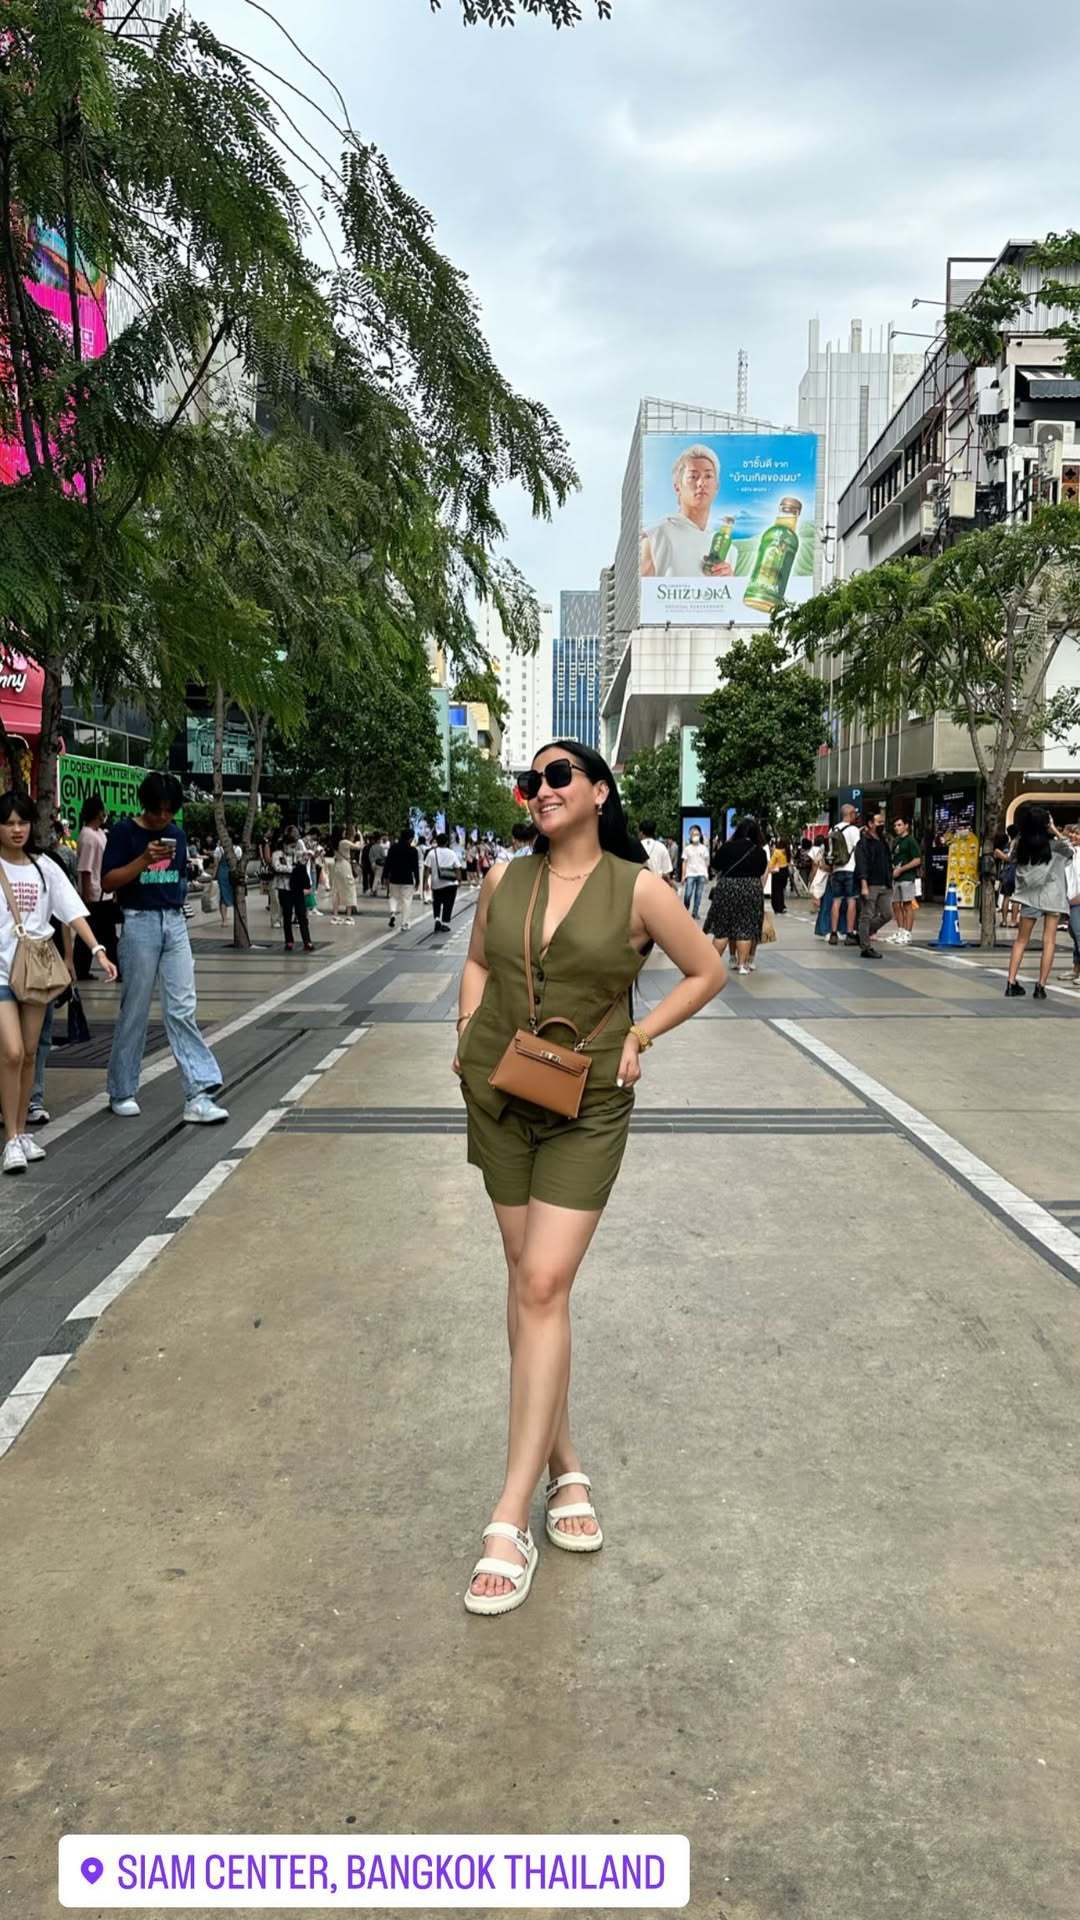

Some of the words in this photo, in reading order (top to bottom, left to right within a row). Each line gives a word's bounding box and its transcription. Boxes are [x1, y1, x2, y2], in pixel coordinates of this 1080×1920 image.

[657, 584, 731, 600] SHIZUOKA
[61, 775, 141, 805] @MATTER
[852, 789, 860, 799] P
